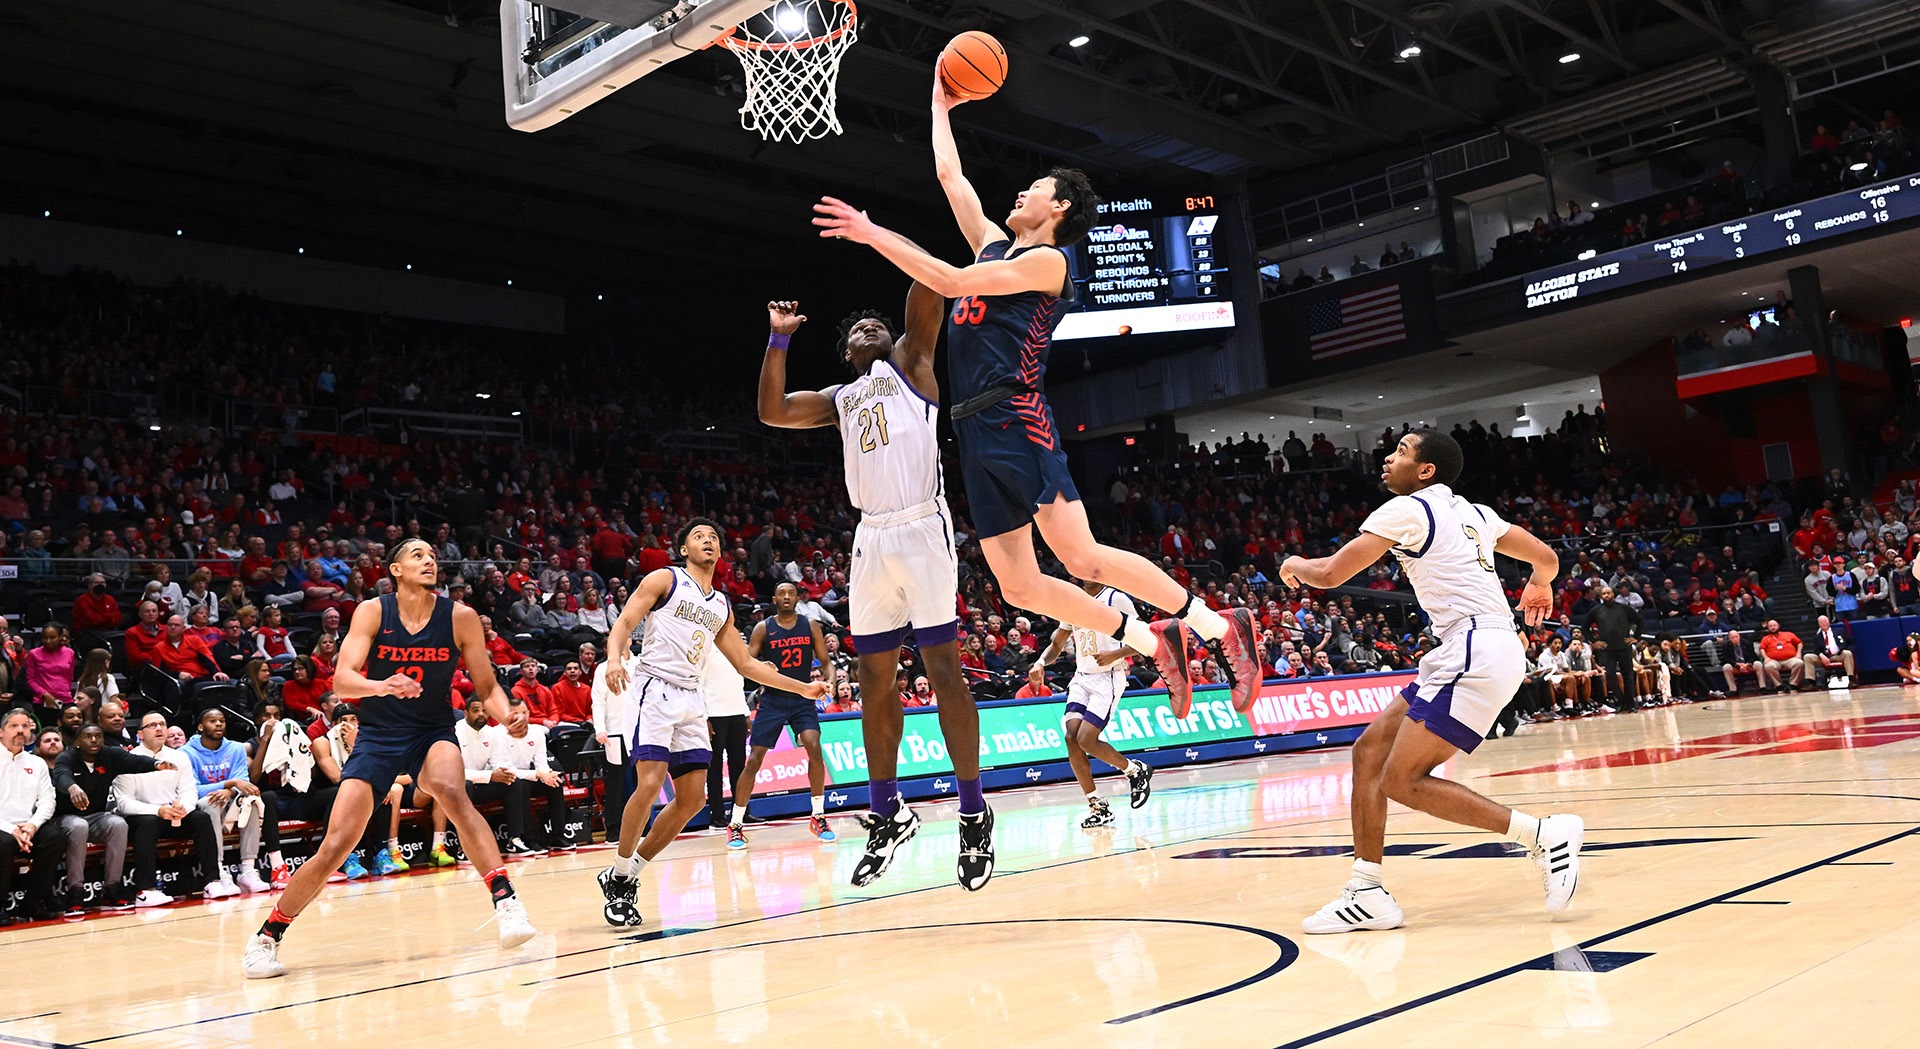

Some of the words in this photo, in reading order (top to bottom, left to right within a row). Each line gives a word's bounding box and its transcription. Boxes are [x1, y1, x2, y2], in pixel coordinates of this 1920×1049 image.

[1860, 184, 1900, 200] Offensive
[1111, 198, 1152, 213] Health
[1185, 196, 1214, 211] 8:47
[1870, 196, 1886, 209] 16
[1773, 208, 1802, 223] Assists
[1814, 210, 1867, 230] REBOUNDS
[1873, 210, 1889, 223] 15
[1722, 222, 1748, 235] Steals
[1785, 218, 1795, 230] 6
[1121, 228, 1150, 240] Allen
[1732, 232, 1741, 243] 5
[1785, 233, 1801, 246] 19
[1088, 243, 1116, 255] FIELD
[1117, 241, 1143, 252] GOAL
[1144, 240, 1153, 250] %
[1654, 242, 1672, 252] Free
[1672, 236, 1695, 248] Throw
[1695, 232, 1705, 241] %
[1096, 257, 1104, 265] 3
[1105, 254, 1135, 265] POINT
[1136, 253, 1145, 262] %
[1669, 246, 1685, 259] 50
[1735, 246, 1744, 258] 3
[1095, 265, 1150, 279] REBOUNDS
[1671, 260, 1687, 273] 74
[1089, 281, 1114, 292] FREE
[1115, 278, 1158, 290] THROWS
[1160, 277, 1169, 286] %
[1525, 273, 1576, 296] ALCORN
[1577, 262, 1620, 282] STATE
[1094, 291, 1155, 304] TURNOVERS
[1526, 285, 1579, 309] DAYTON
[1175, 309, 1230, 323] ROOFING
[858, 402, 889, 454] 21
[686, 629, 705, 665] 3
[770, 635, 811, 650] FLYERS
[1079, 630, 1098, 657] 23
[377, 644, 450, 662] FLYERS
[781, 647, 803, 668] 23
[1252, 686, 1330, 724] MIKE'S
[992, 723, 1061, 754] make
[1025, 767, 1042, 781] Kroger
[933, 778, 951, 793] Kroger
[828, 791, 849, 806] Kroger
